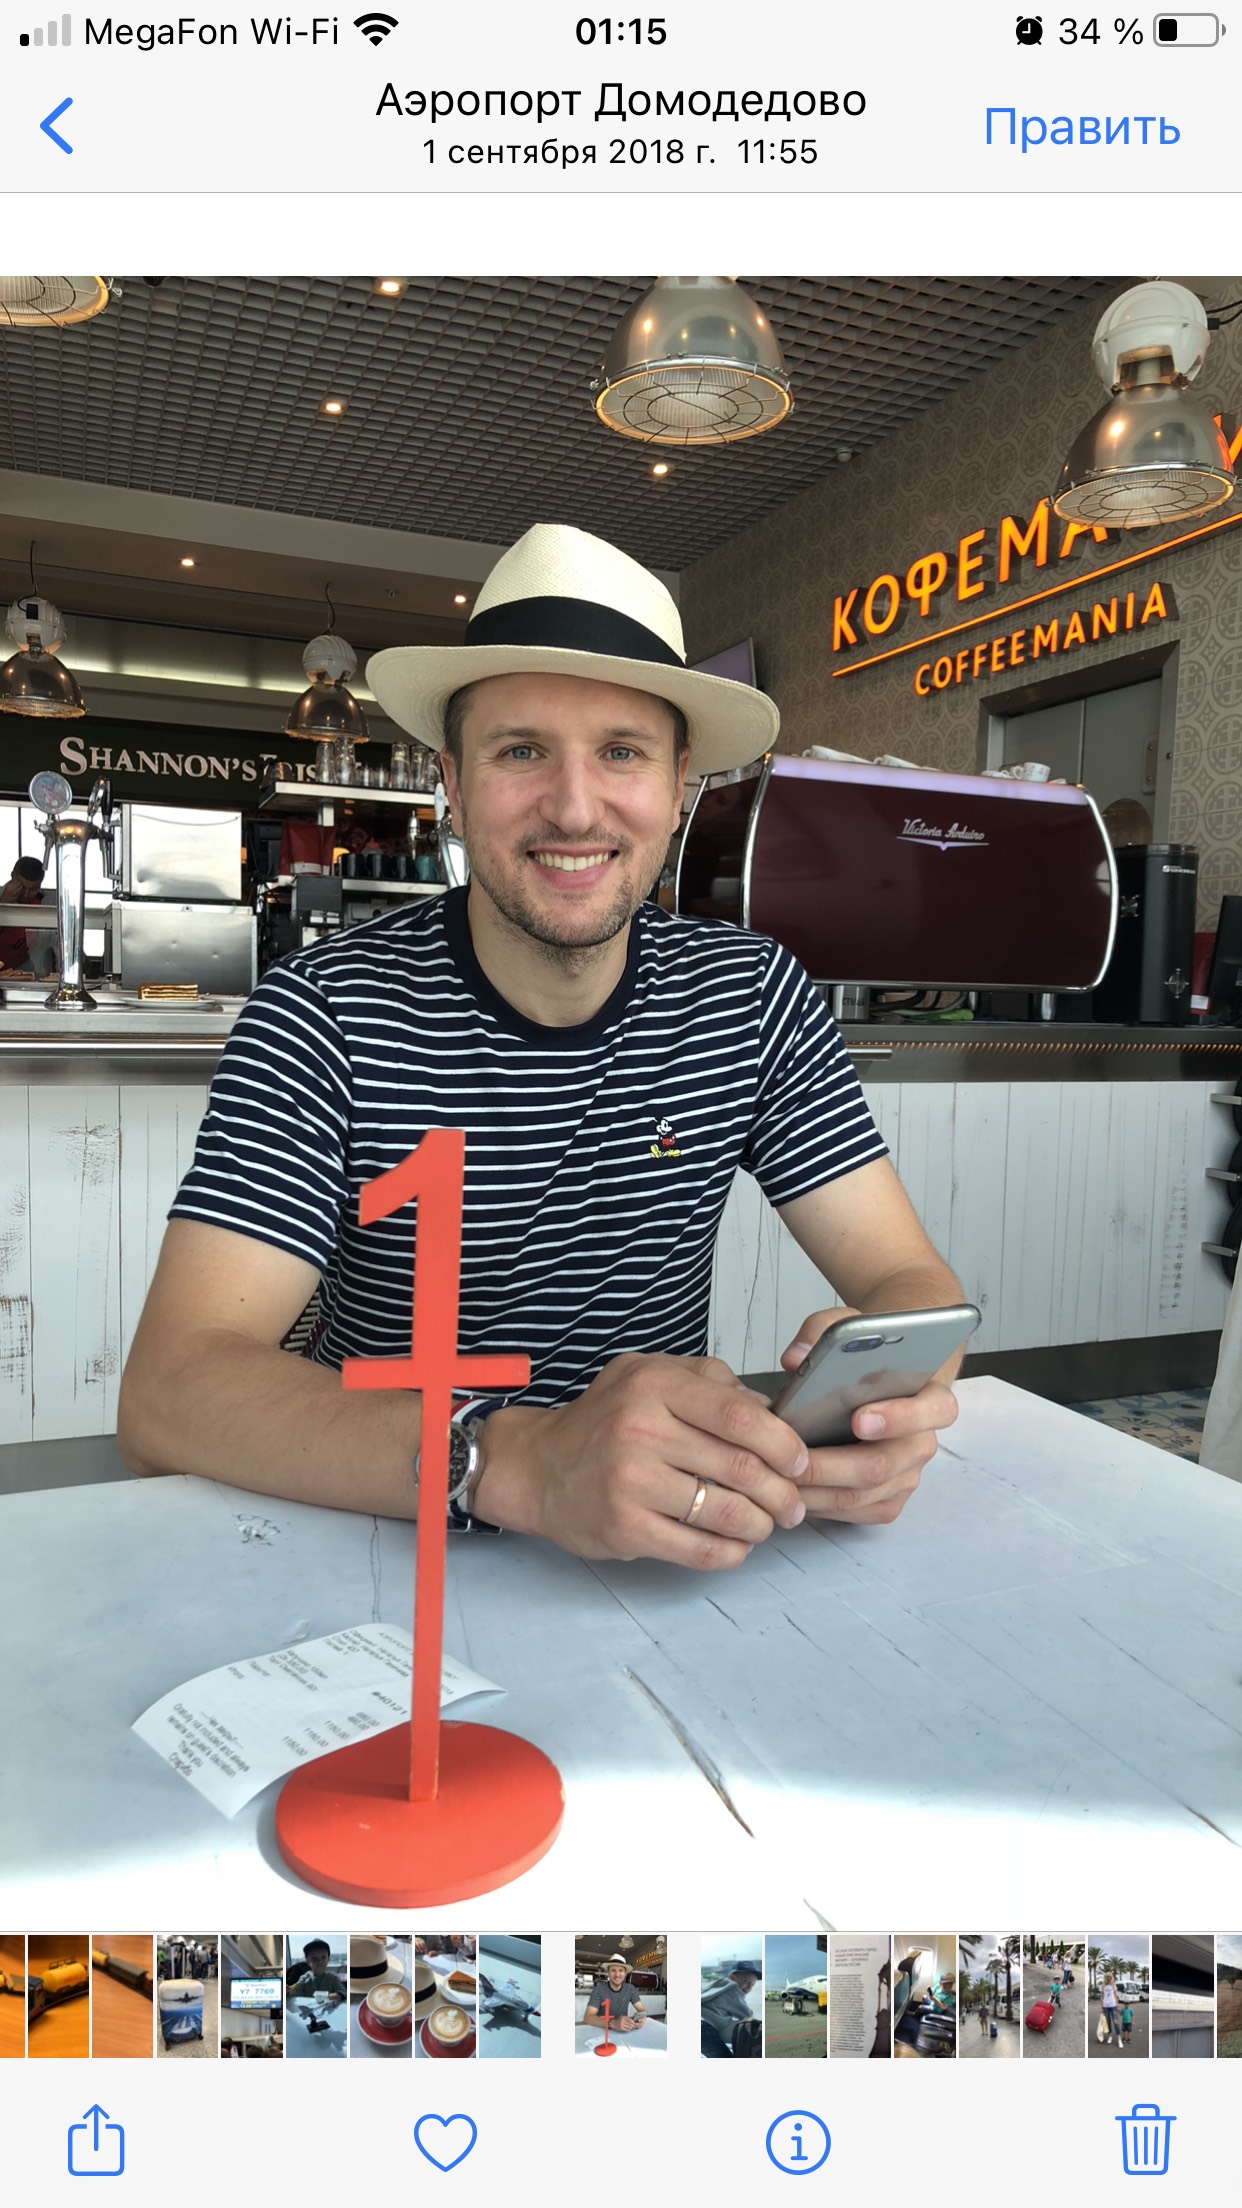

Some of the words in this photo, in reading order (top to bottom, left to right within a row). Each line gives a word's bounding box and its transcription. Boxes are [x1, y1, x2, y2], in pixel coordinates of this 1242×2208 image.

[914, 582, 1168, 696] COFFEEMANIA
[902, 818, 942, 837] Victoria
[945, 822, 985, 841] Arduino
